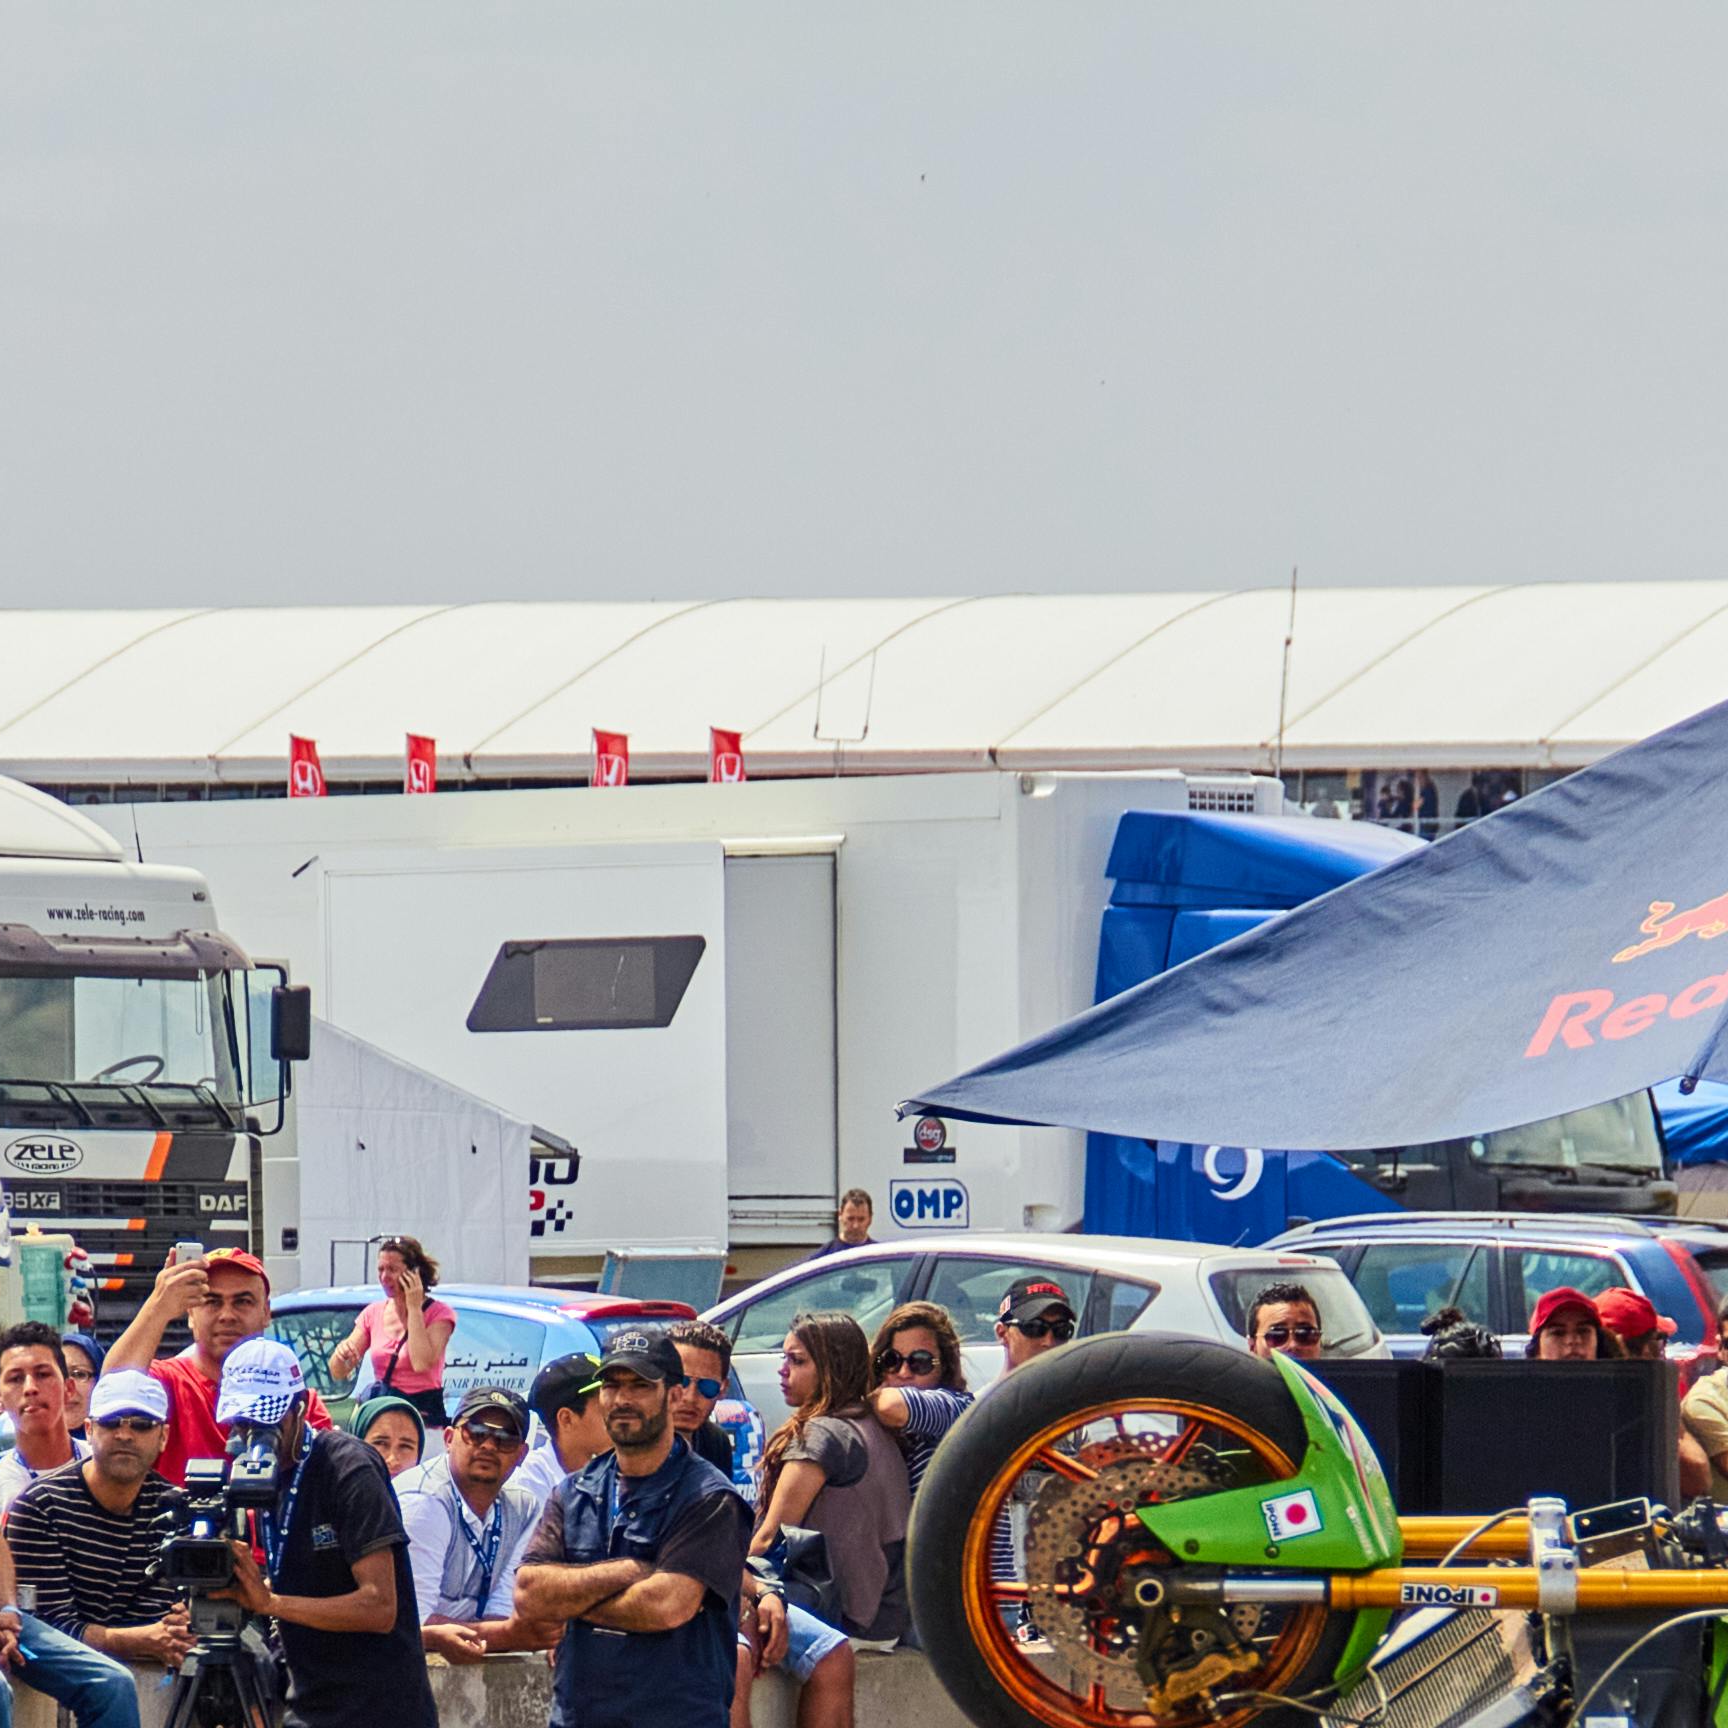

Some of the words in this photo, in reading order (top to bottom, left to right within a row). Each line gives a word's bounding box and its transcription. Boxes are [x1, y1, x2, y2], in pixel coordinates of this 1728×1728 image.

[46, 902, 146, 926] www.zele-racing.com
[199, 1194, 247, 1211] DAF
[894, 1188, 964, 1219] OMP
[484, 1352, 528, 1374] منير
[1265, 1503, 1281, 1537] IPONE
[1403, 1585, 1475, 1604] IPONE
